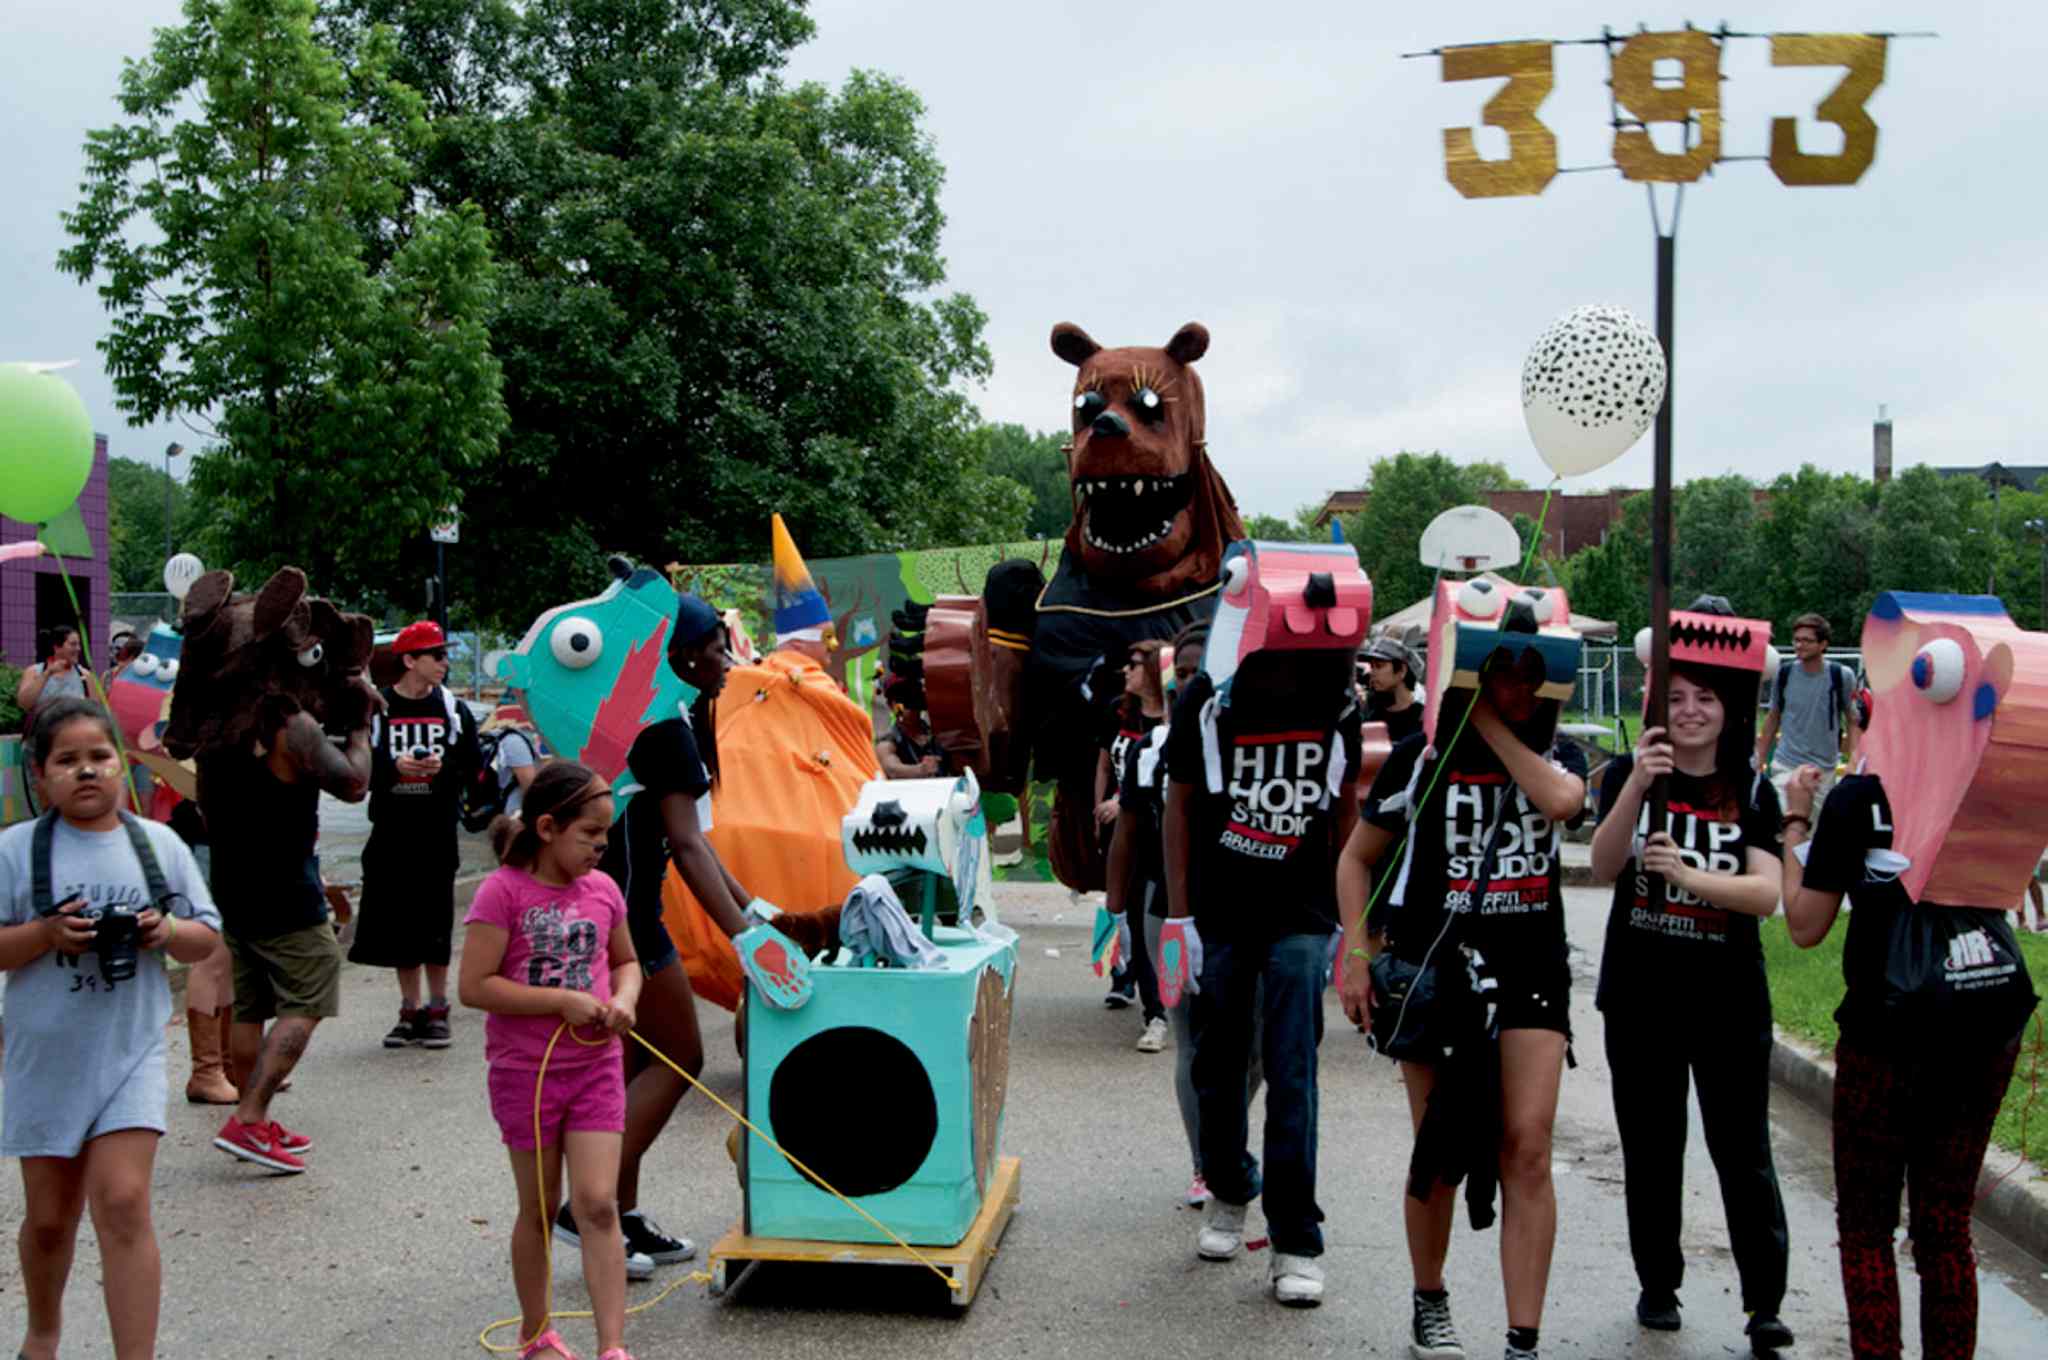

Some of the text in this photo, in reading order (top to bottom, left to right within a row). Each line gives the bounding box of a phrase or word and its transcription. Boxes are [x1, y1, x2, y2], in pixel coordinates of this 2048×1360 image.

[1441, 31, 1889, 199] 393
[389, 723, 445, 745] HIP
[1233, 741, 1324, 779] HIP
[1229, 778, 1321, 814] HOP
